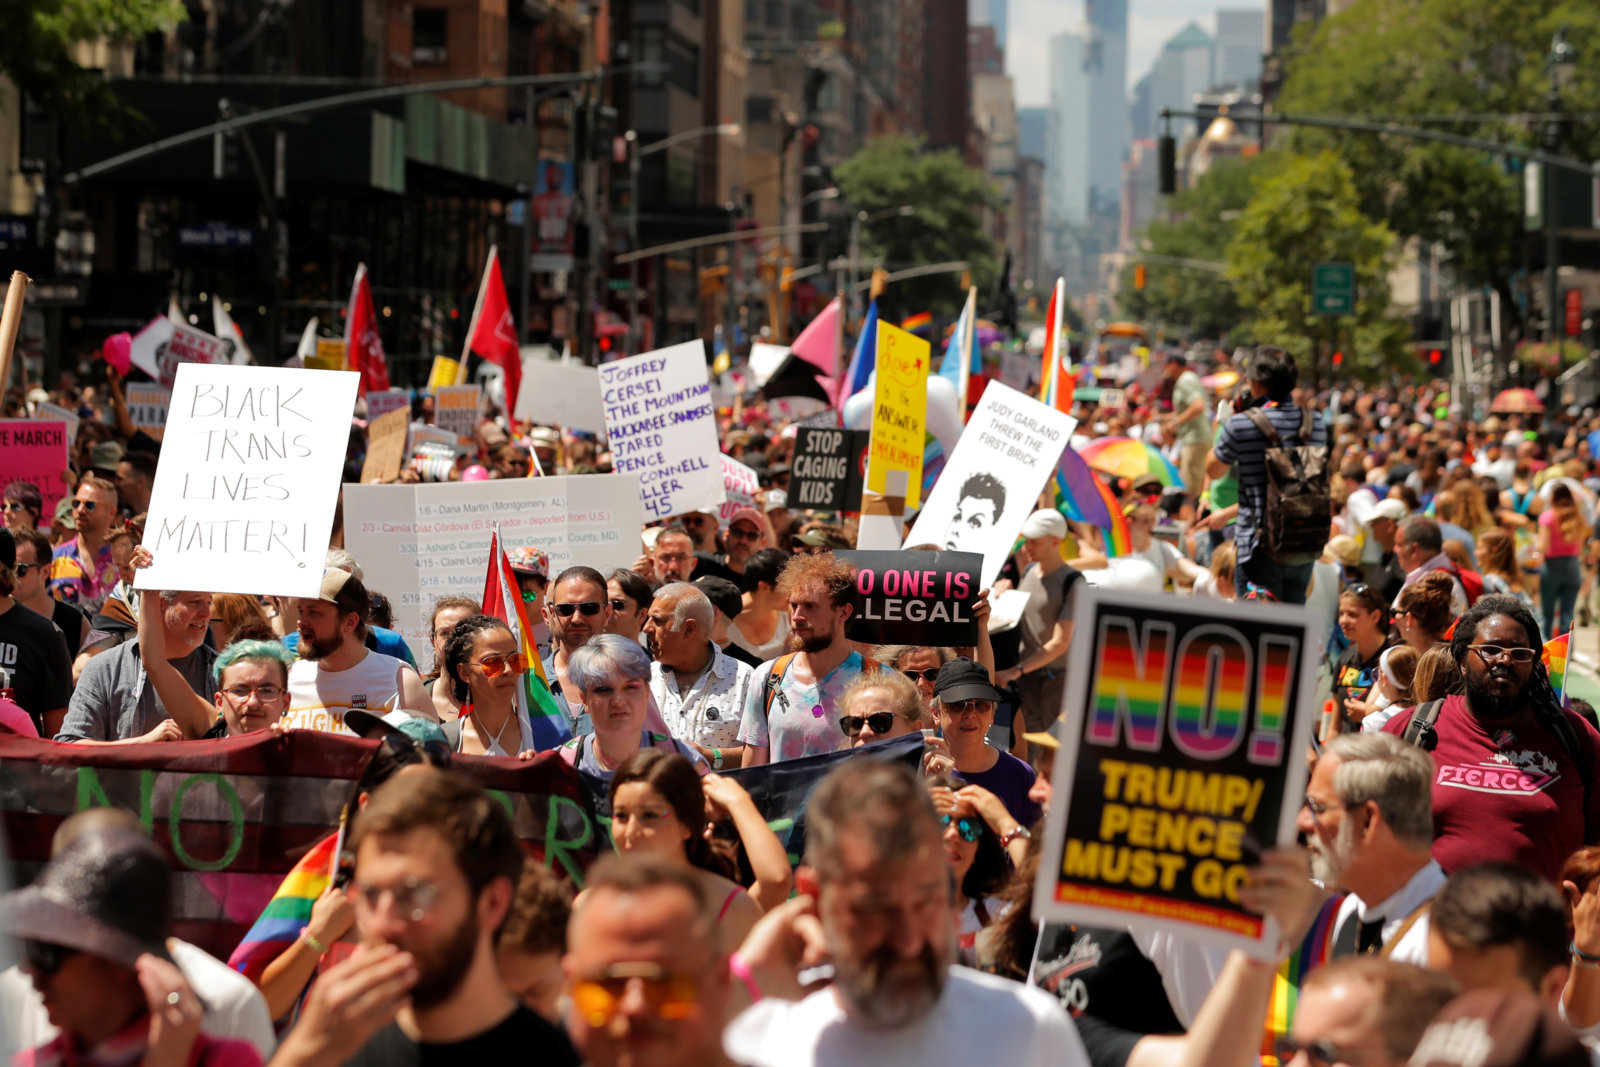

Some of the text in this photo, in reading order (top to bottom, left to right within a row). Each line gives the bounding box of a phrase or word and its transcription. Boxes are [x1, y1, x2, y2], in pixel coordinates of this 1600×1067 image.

[603, 358, 667, 384] JOFFREY
[605, 378, 662, 404] CERSEI
[608, 383, 711, 421] THE MOUNTAIN
[191, 384, 313, 427] BLACK
[609, 416, 667, 440] HUCKABEE
[877, 403, 920, 436] ANSWER
[987, 401, 1060, 442] JUDY GARLAND
[13, 430, 62, 446] MARCH
[192, 429, 312, 464] TRANS
[614, 433, 663, 458] JARED
[806, 431, 842, 453] STOP
[990, 418, 1045, 453] THREW THE
[616, 452, 665, 473] PENCE
[979, 432, 1037, 468] FIRST BRICK
[640, 456, 709, 484] CONNELL
[793, 455, 847, 479] CAGING
[182, 472, 290, 501] LIVES
[640, 479, 684, 500] LLER
[798, 482, 834, 504] KIDS
[438, 505, 461, 514] Dana
[463, 503, 489, 512] Martin
[529, 514, 565, 526] deported
[568, 512, 587, 522] from
[645, 496, 673, 517] 45
[155, 515, 307, 568] MATTER!
[415, 558, 434, 568] 4/15
[441, 557, 464, 567] Claire
[448, 574, 485, 585] Muhlaysi
[851, 568, 970, 599] O ONE IS
[856, 598, 969, 623] LEGAL
[1086, 615, 1298, 766] NO!
[1436, 765, 1539, 791] FIERCE
[1101, 760, 1265, 823] TRUMP/
[1100, 803, 1246, 861] PENCE
[1063, 840, 1186, 891] MUST
